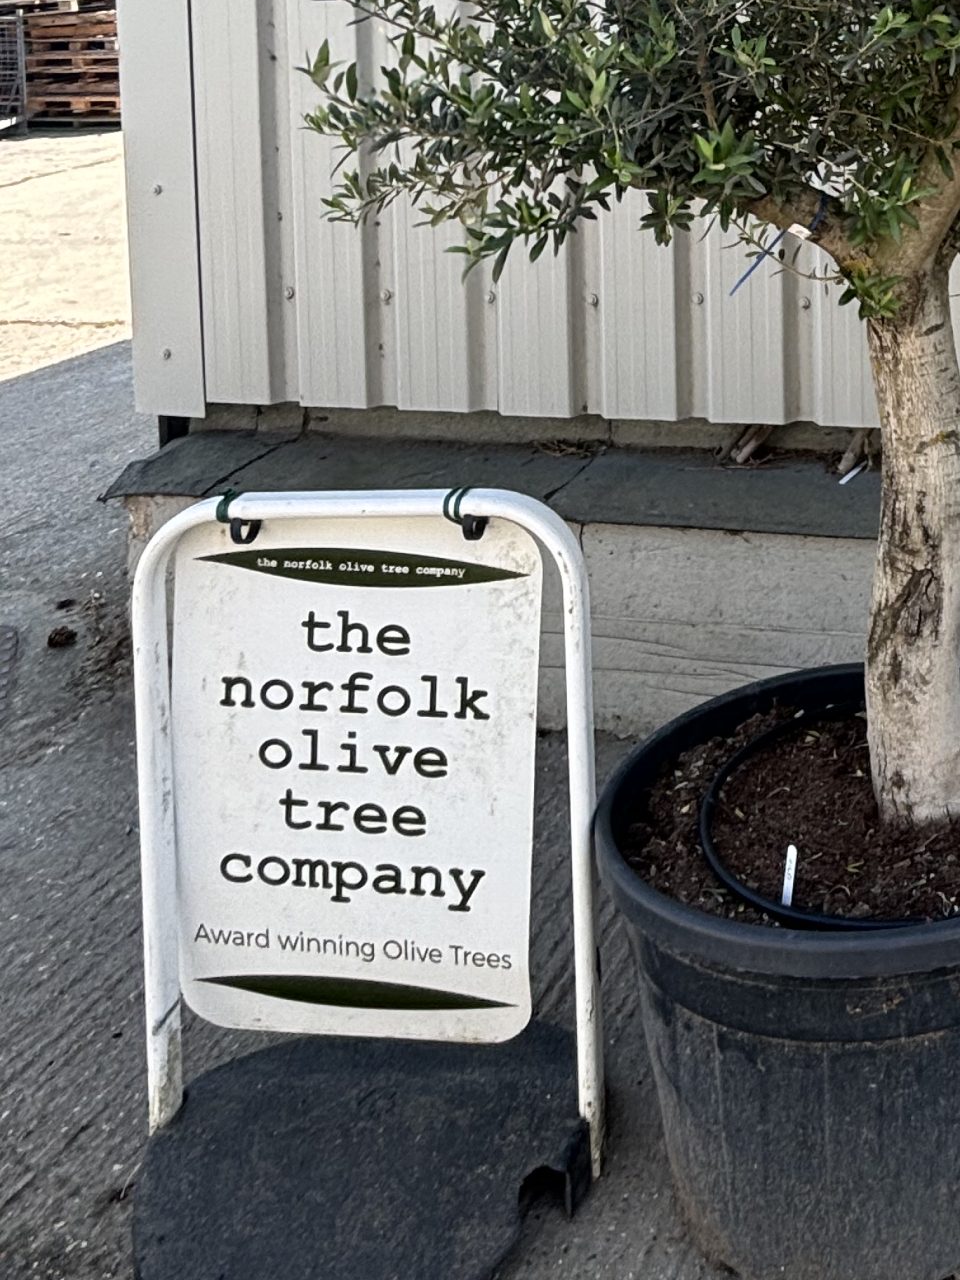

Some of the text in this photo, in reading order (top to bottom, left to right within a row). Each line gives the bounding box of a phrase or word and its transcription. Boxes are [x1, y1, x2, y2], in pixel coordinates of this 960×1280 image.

[257, 558, 465, 579] the norfolk olive tree company
[301, 610, 411, 656] the
[219, 672, 490, 720] norfolk
[258, 729, 448, 778] olive
[279, 788, 426, 837] tree
[220, 853, 486, 912] company
[193, 923, 512, 970] Award winning Olive Trees
